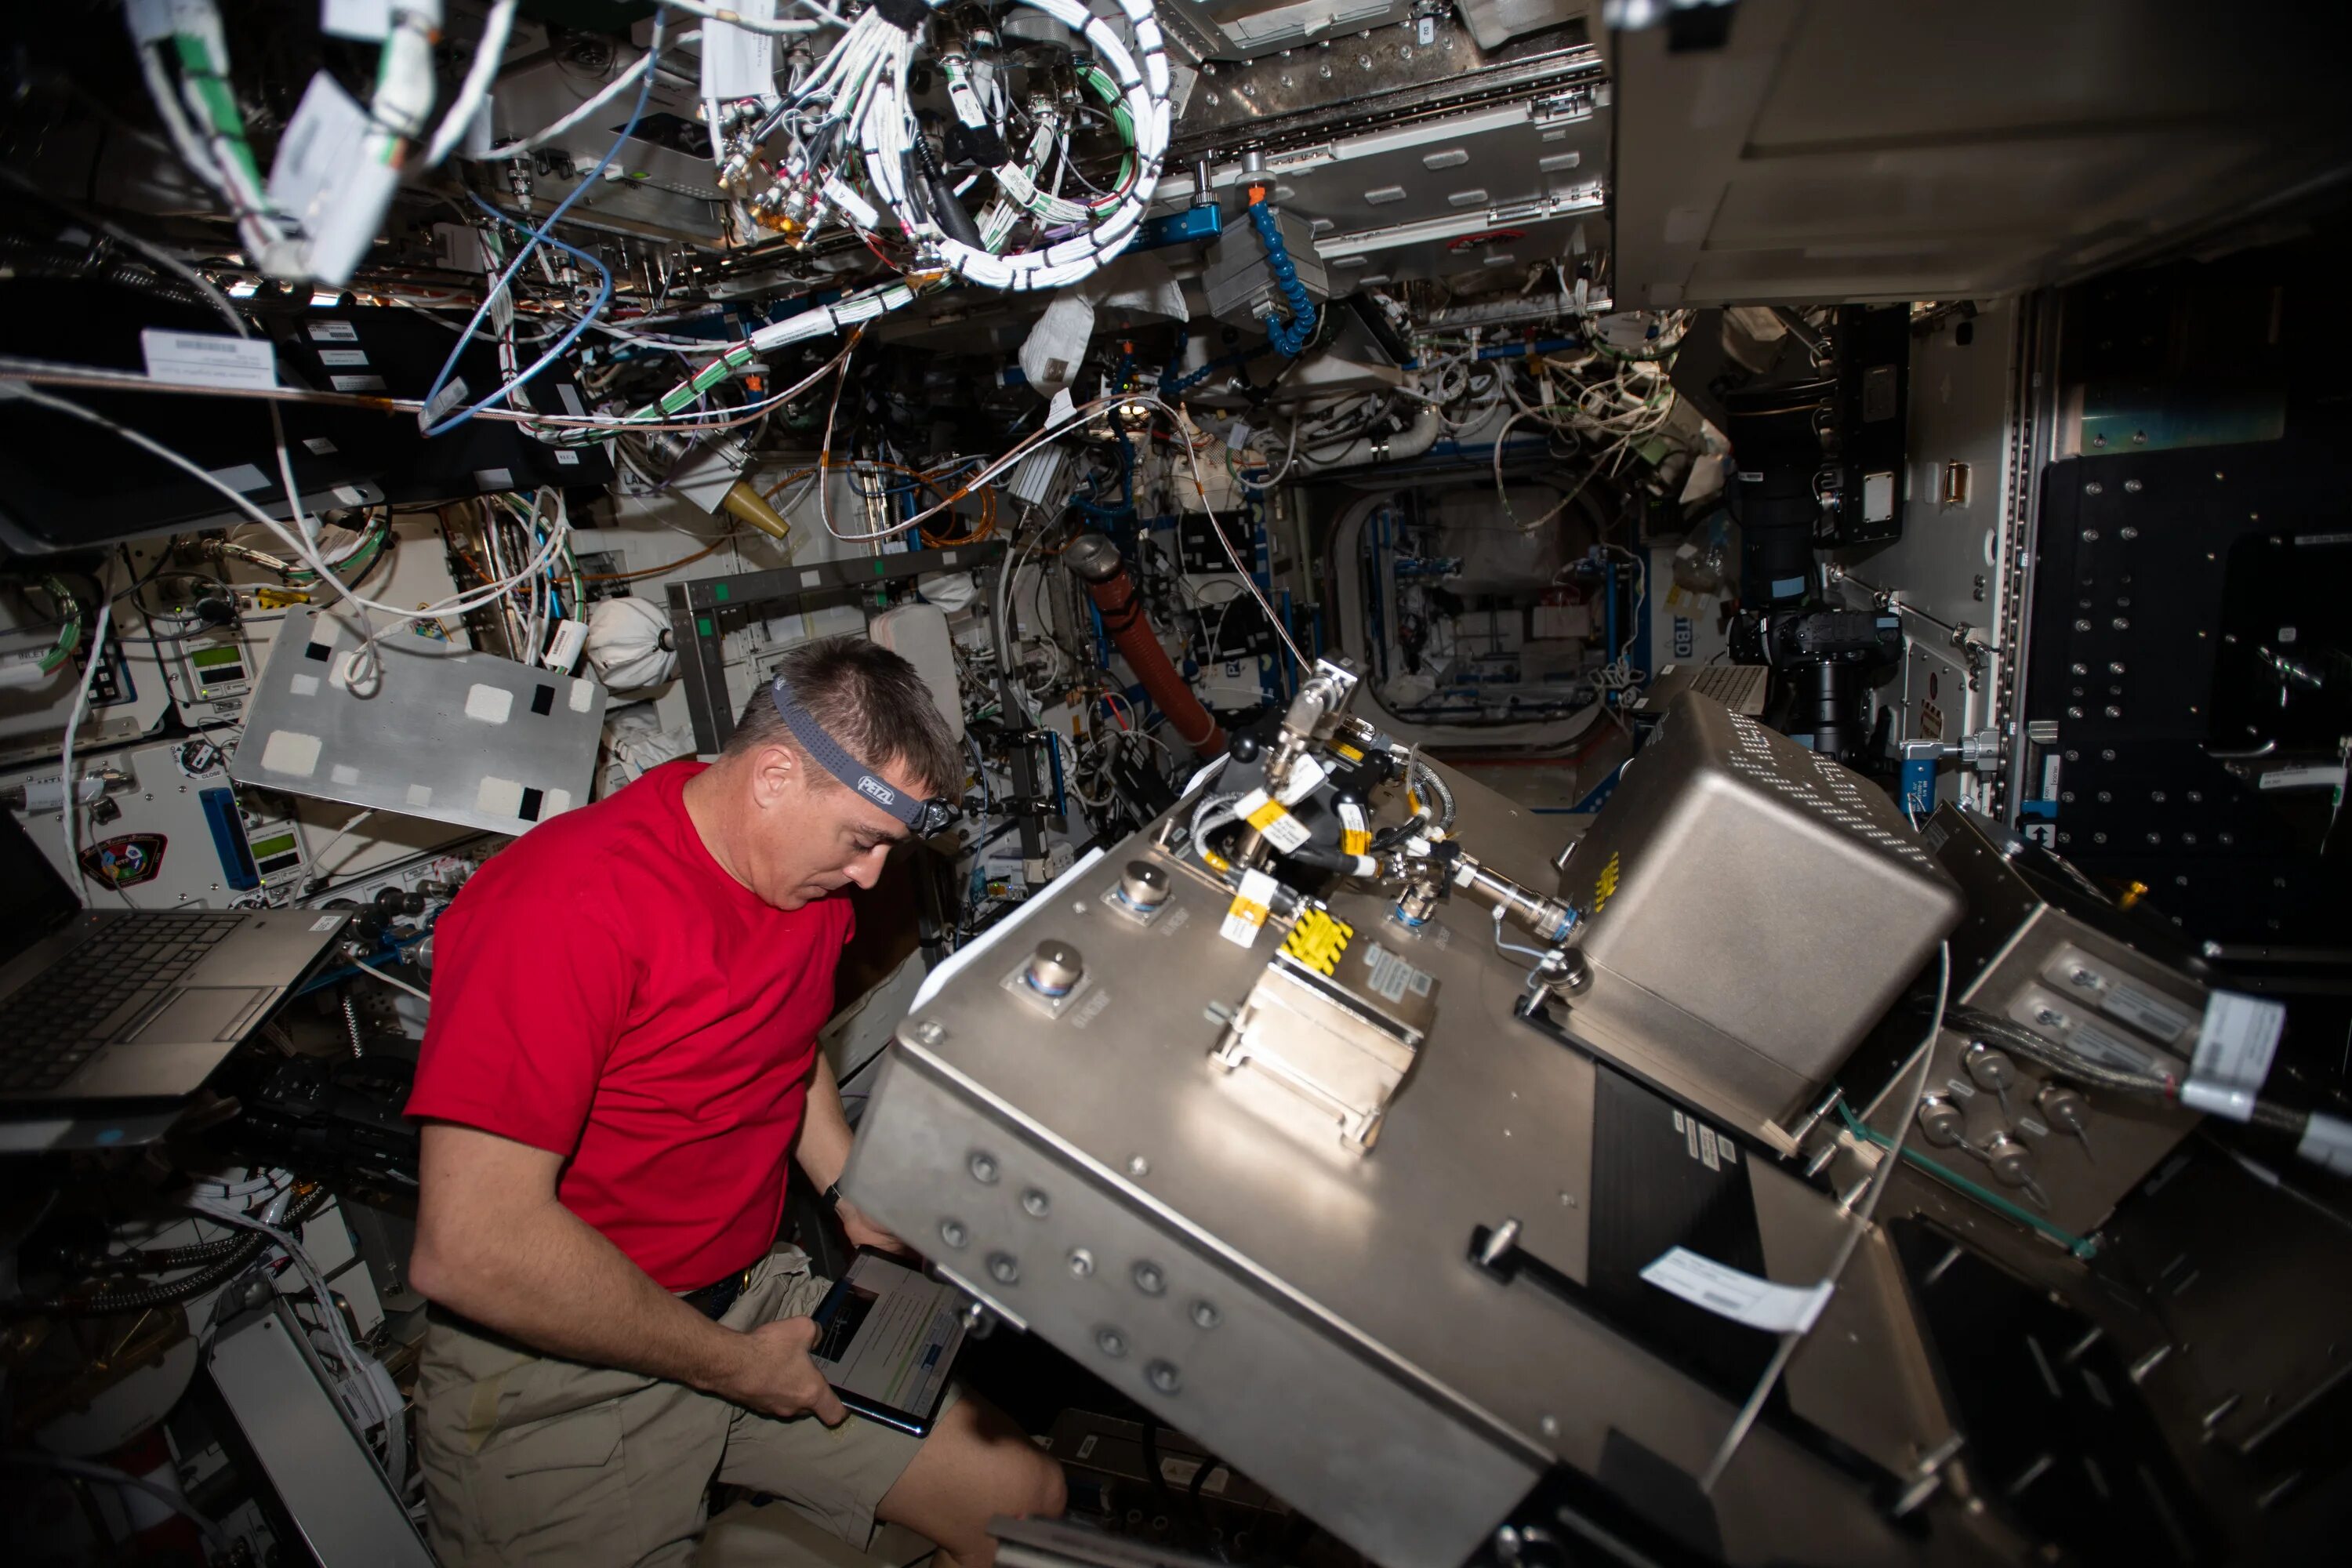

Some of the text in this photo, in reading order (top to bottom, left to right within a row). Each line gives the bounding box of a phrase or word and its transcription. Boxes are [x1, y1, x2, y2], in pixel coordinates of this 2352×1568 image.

[1675, 615, 1692, 656] TBD
[19, 650, 45, 660] INLET
[201, 770, 220, 779] CLOSE
[858, 776, 894, 805] PETZL
